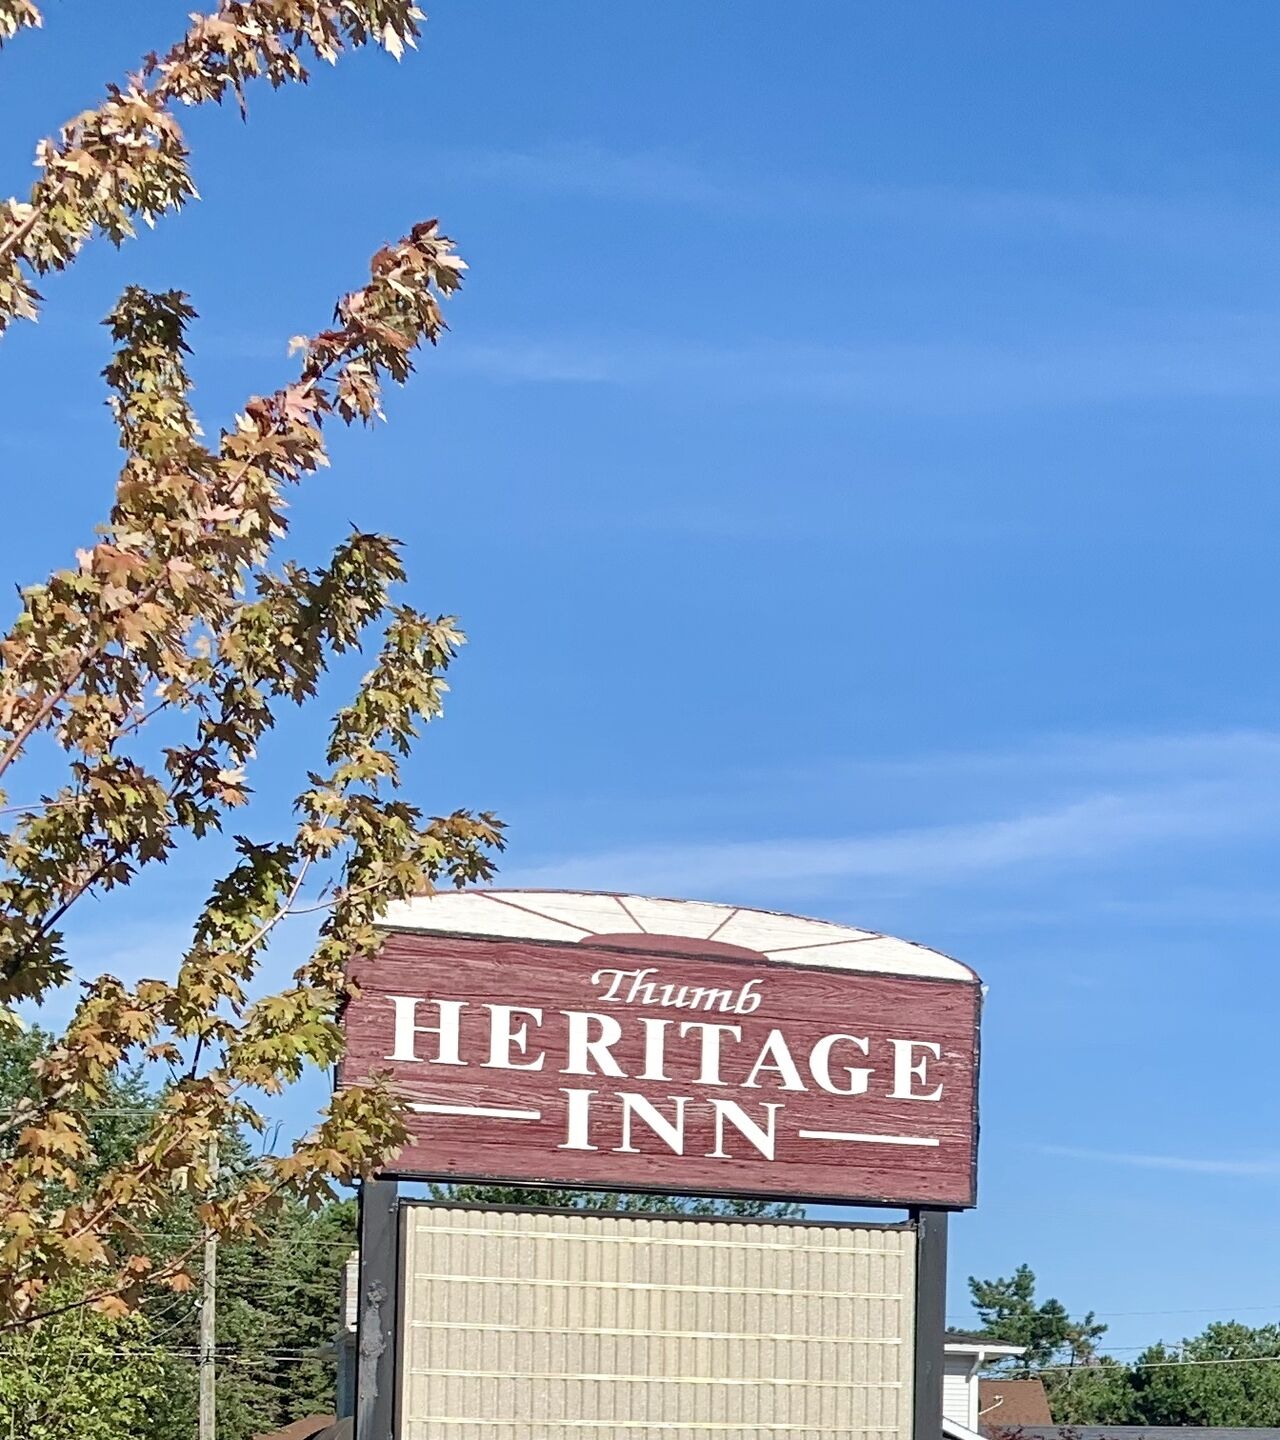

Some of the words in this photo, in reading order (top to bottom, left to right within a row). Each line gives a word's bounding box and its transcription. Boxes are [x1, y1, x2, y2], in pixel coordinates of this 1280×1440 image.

[591, 967, 764, 1015] Thumb
[383, 994, 944, 1102] HERITAGE
[557, 1087, 786, 1161] INN
